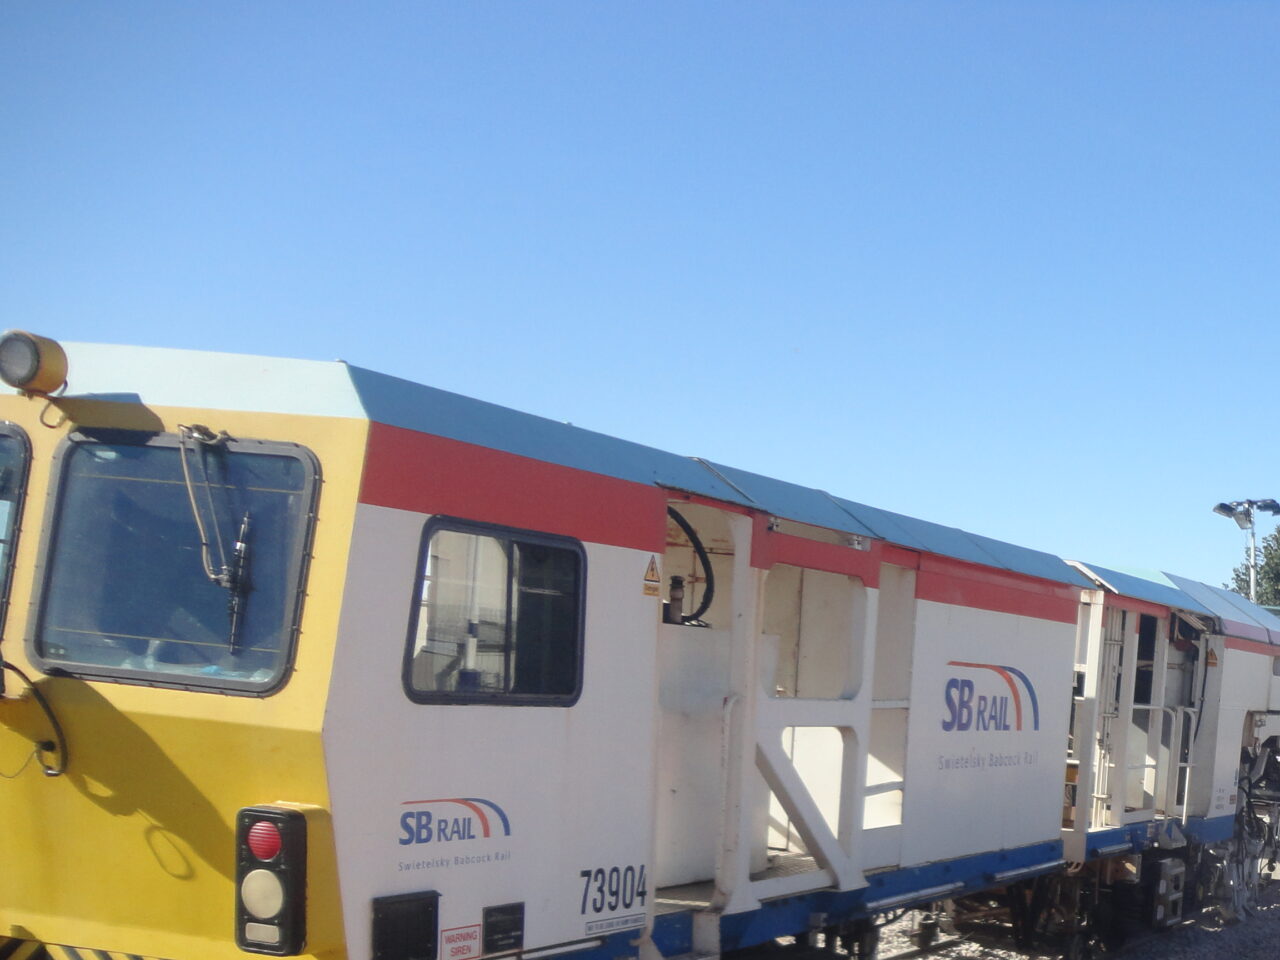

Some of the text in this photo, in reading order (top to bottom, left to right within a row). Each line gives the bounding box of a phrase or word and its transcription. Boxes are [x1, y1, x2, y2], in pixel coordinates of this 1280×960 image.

[942, 678, 1011, 732] SB RAIL
[399, 811, 476, 845] SB RAIL
[398, 850, 511, 871] Swietelsky Babcock Rail
[580, 864, 648, 915] 73904
[444, 930, 478, 944] WARNING
[450, 945, 472, 957] SIREN
